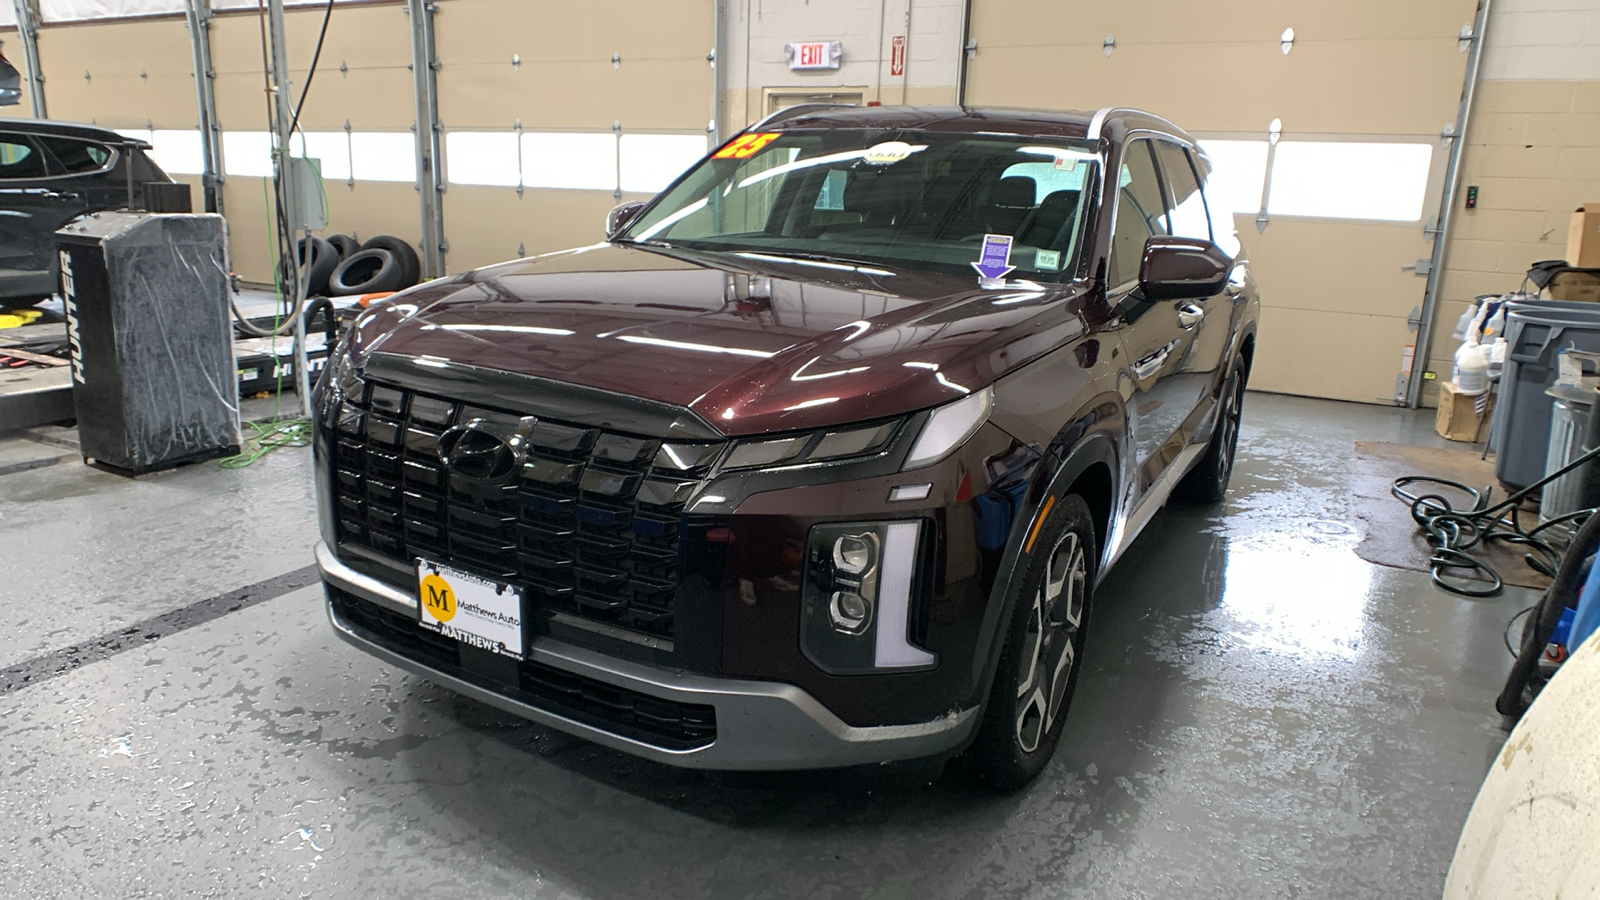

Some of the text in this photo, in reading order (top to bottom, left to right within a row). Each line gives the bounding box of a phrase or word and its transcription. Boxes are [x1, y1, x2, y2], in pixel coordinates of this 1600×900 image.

[801, 44, 823, 65] EXIT
[716, 133, 781, 158] 25
[60, 250, 85, 385] HUNTER
[426, 584, 450, 613] M
[457, 599, 520, 626] Matthews Auto
[441, 625, 499, 653] MATTHEWS
